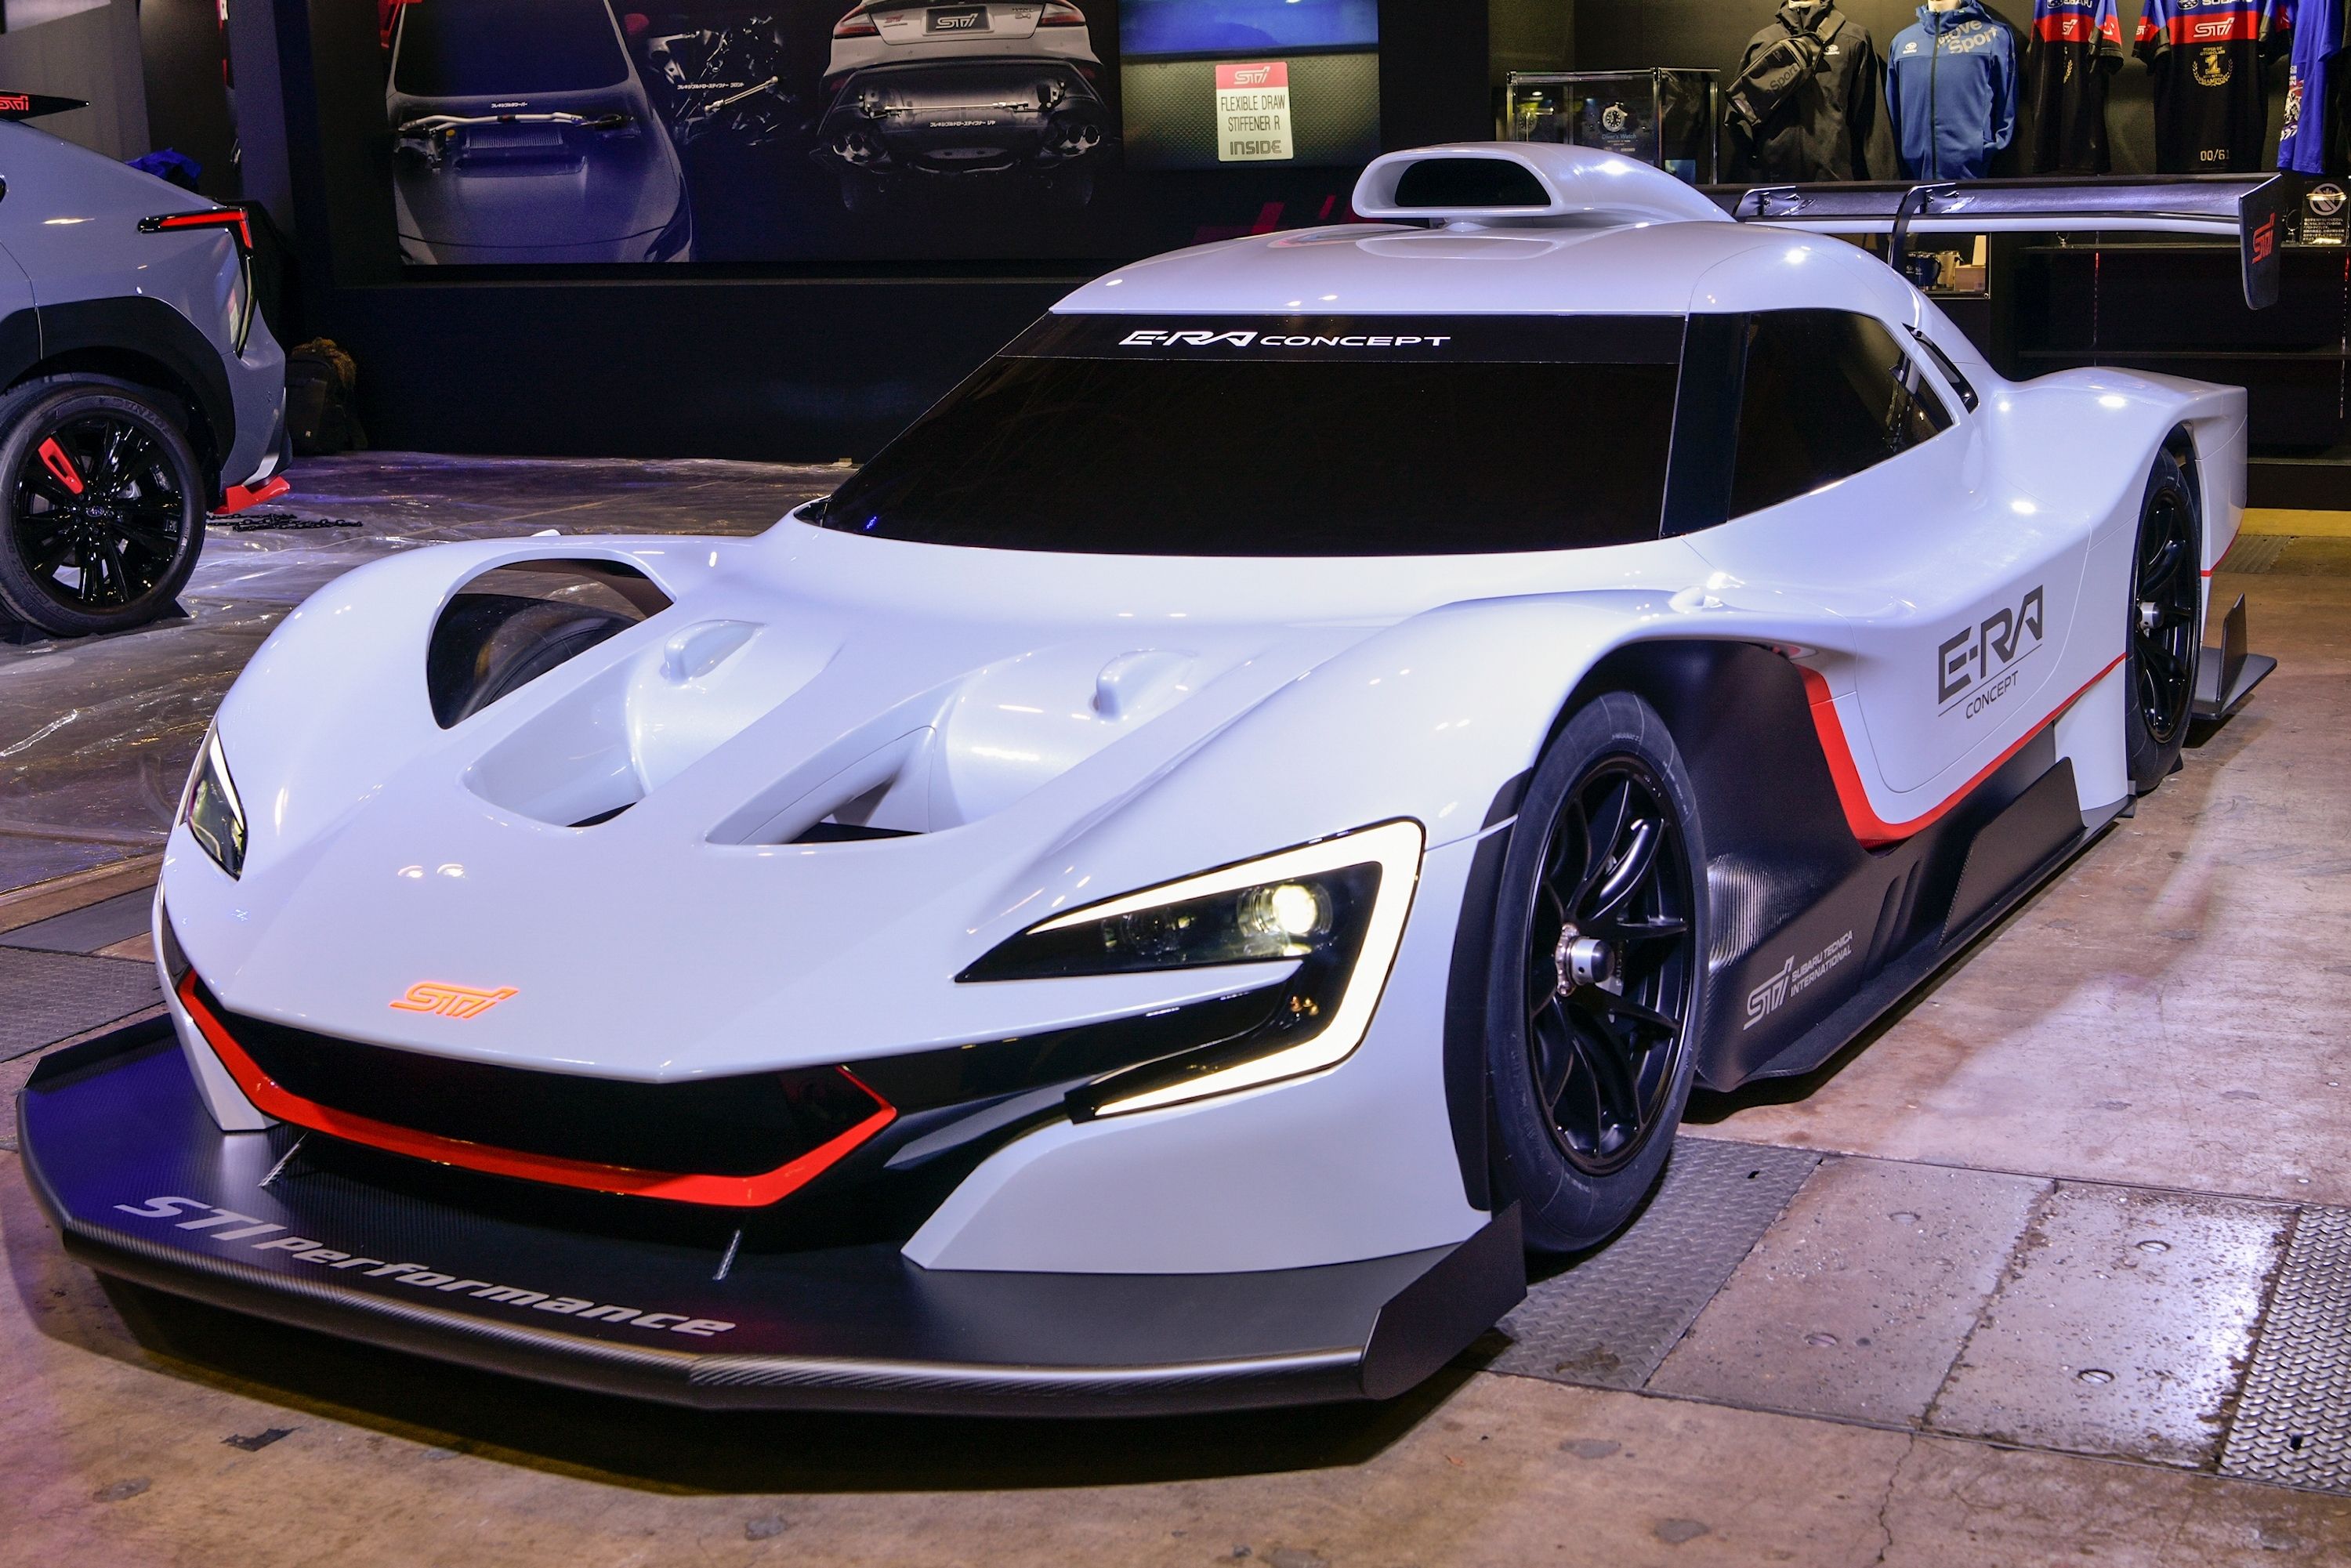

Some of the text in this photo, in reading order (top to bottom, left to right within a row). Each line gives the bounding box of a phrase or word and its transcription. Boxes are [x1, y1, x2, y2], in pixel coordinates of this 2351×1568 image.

[936, 13, 979, 30] STI
[2193, 17, 2235, 38] STI
[1948, 27, 1998, 54] Sport
[1234, 66, 1270, 85] STI
[1770, 65, 1799, 92] Sport
[1221, 95, 1285, 111] FLEXIBLE DRAW
[1228, 115, 1281, 132] STIFFENER R
[1230, 139, 1282, 155] INSIDE
[2251, 212, 2276, 264] STI
[1118, 330, 1451, 347] E-RA CONCEPT
[1938, 585, 2043, 704] E-RA
[1965, 670, 2019, 719] CONCEPT
[1791, 930, 1853, 982] SUBARU TECNICA
[1790, 944, 1853, 998] INTERNATIONAL
[389, 982, 520, 1019] STI
[1743, 954, 1795, 1031] STI
[114, 1196, 290, 1241] STI
